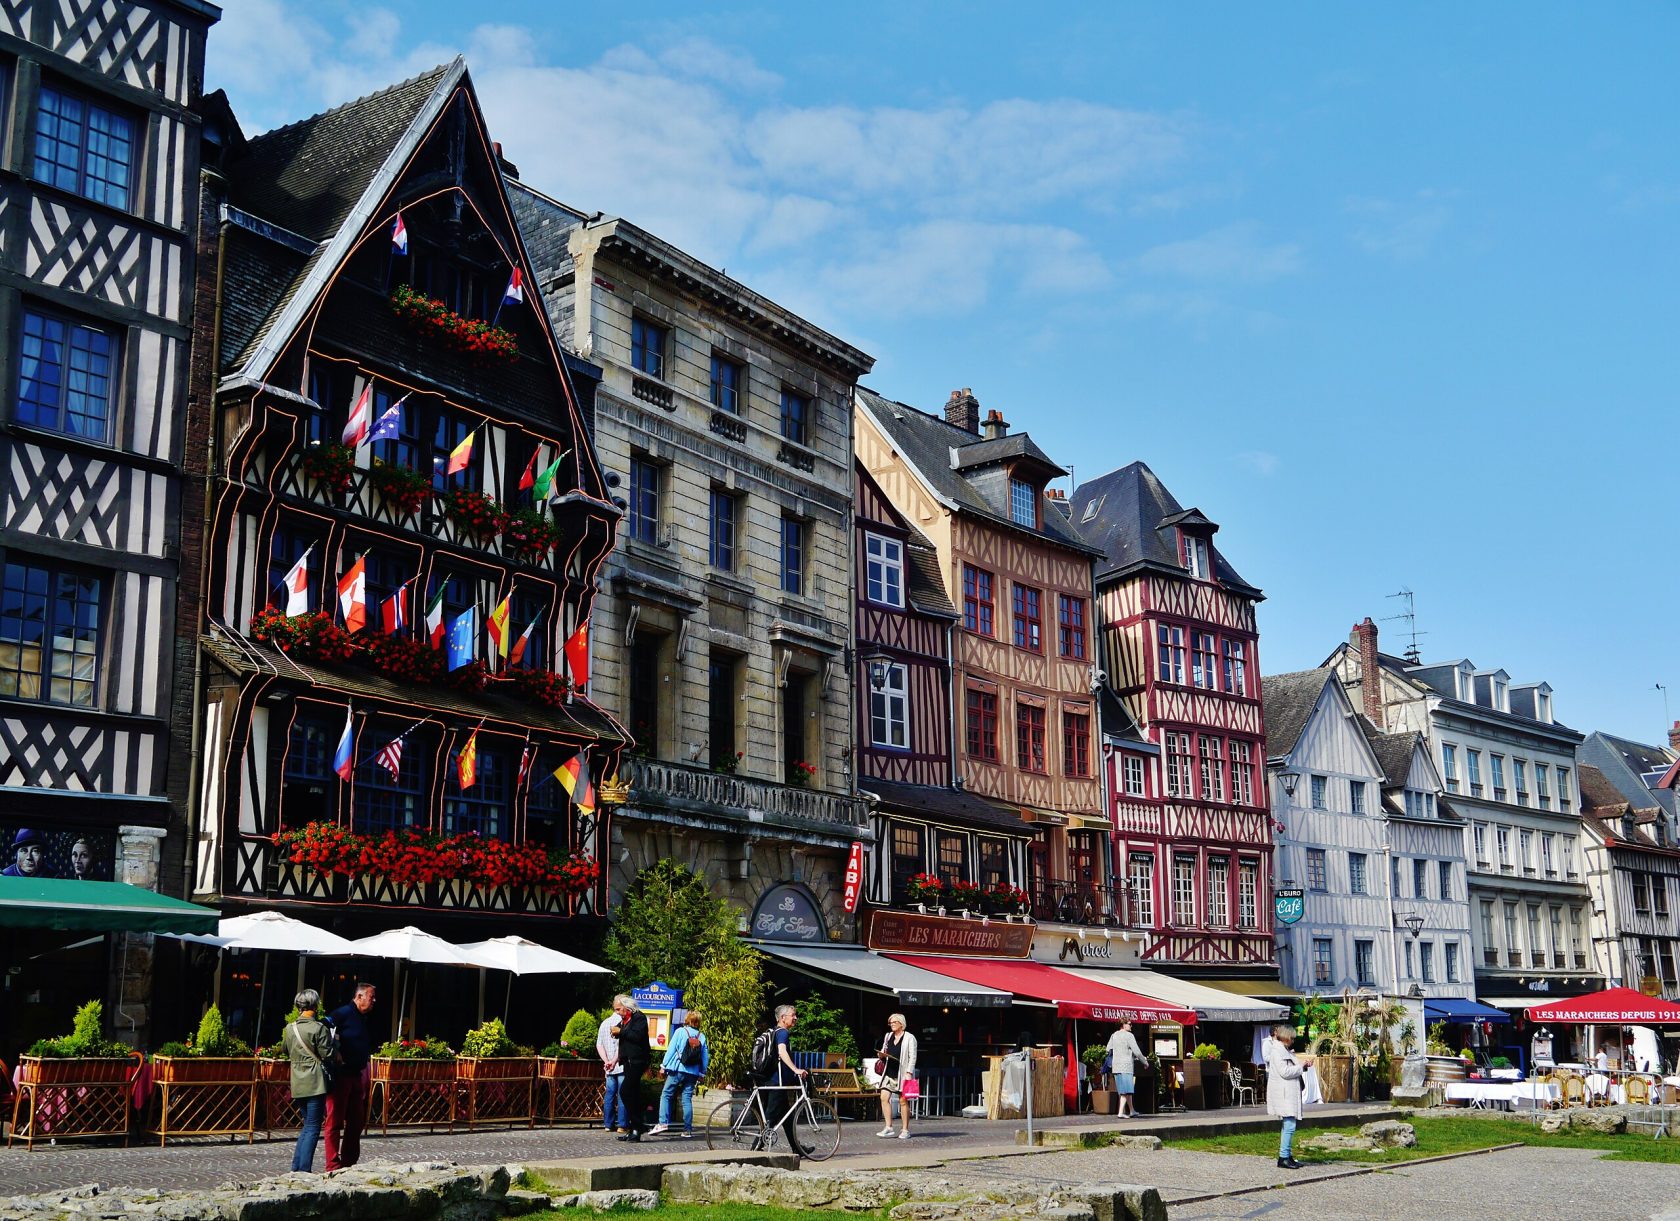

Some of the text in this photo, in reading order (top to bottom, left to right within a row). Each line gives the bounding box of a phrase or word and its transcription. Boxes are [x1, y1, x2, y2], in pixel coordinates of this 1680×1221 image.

[844, 845, 859, 910] TABAC
[1277, 899, 1301, 919] Café
[908, 926, 929, 944] LES
[932, 928, 1001, 949] MARAICHERS
[1059, 938, 1112, 962] Marcel
[1092, 1008, 1103, 1018] LES
[1139, 1011, 1158, 1021] DEPUIS
[1536, 1011, 1554, 1019] LES
[1555, 1011, 1619, 1019] MARAICHERS
[1621, 1011, 1656, 1019] DEPUIS
